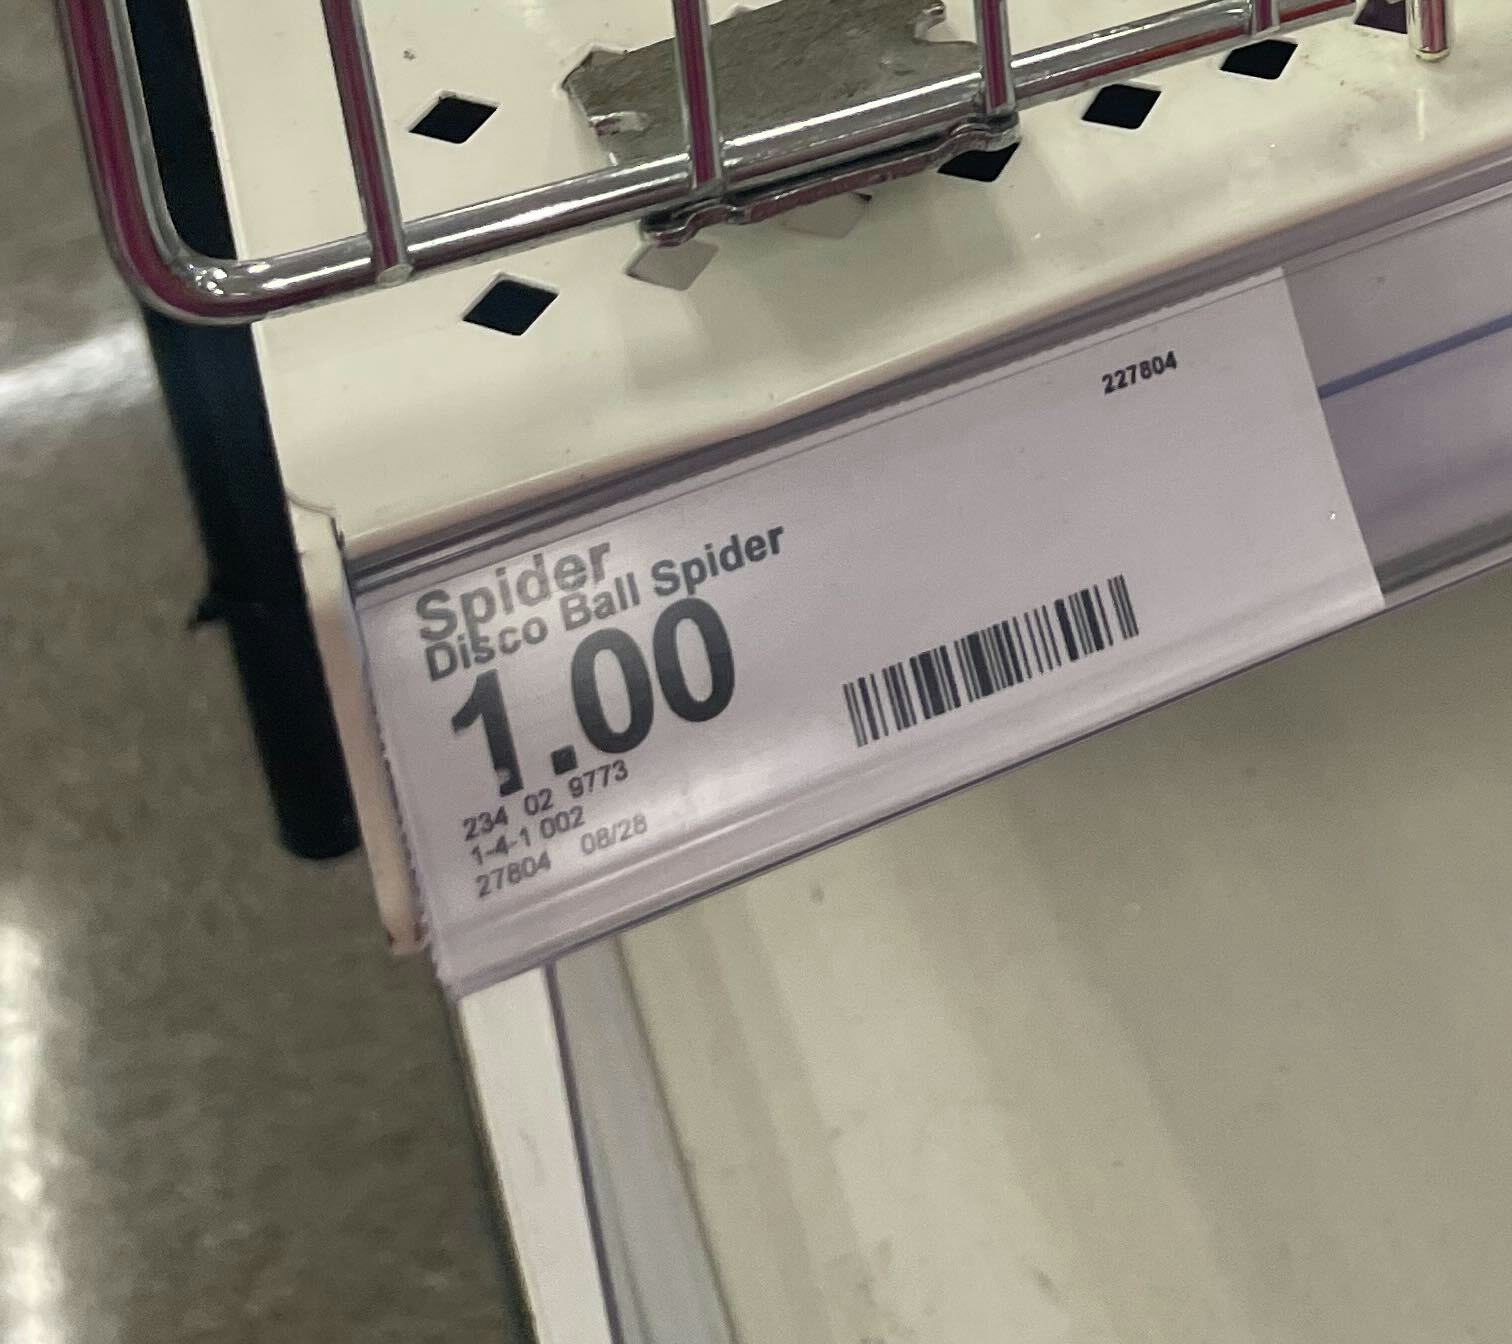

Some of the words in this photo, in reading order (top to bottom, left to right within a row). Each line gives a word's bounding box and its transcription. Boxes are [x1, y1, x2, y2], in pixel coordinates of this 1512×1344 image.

[1101, 350, 1178, 395] 227804
[415, 541, 611, 651] Spider
[425, 615, 549, 682] Disco
[559, 571, 641, 632] Ball
[650, 525, 785, 597] Spider
[450, 597, 736, 798] 1.00
[462, 805, 509, 842] 234
[523, 787, 554, 816] 02
[567, 759, 629, 799] 9773
[471, 826, 531, 866] 1-4-1
[540, 805, 586, 839] 002
[475, 850, 552, 899] 27804
[580, 813, 648, 855] 08/28
